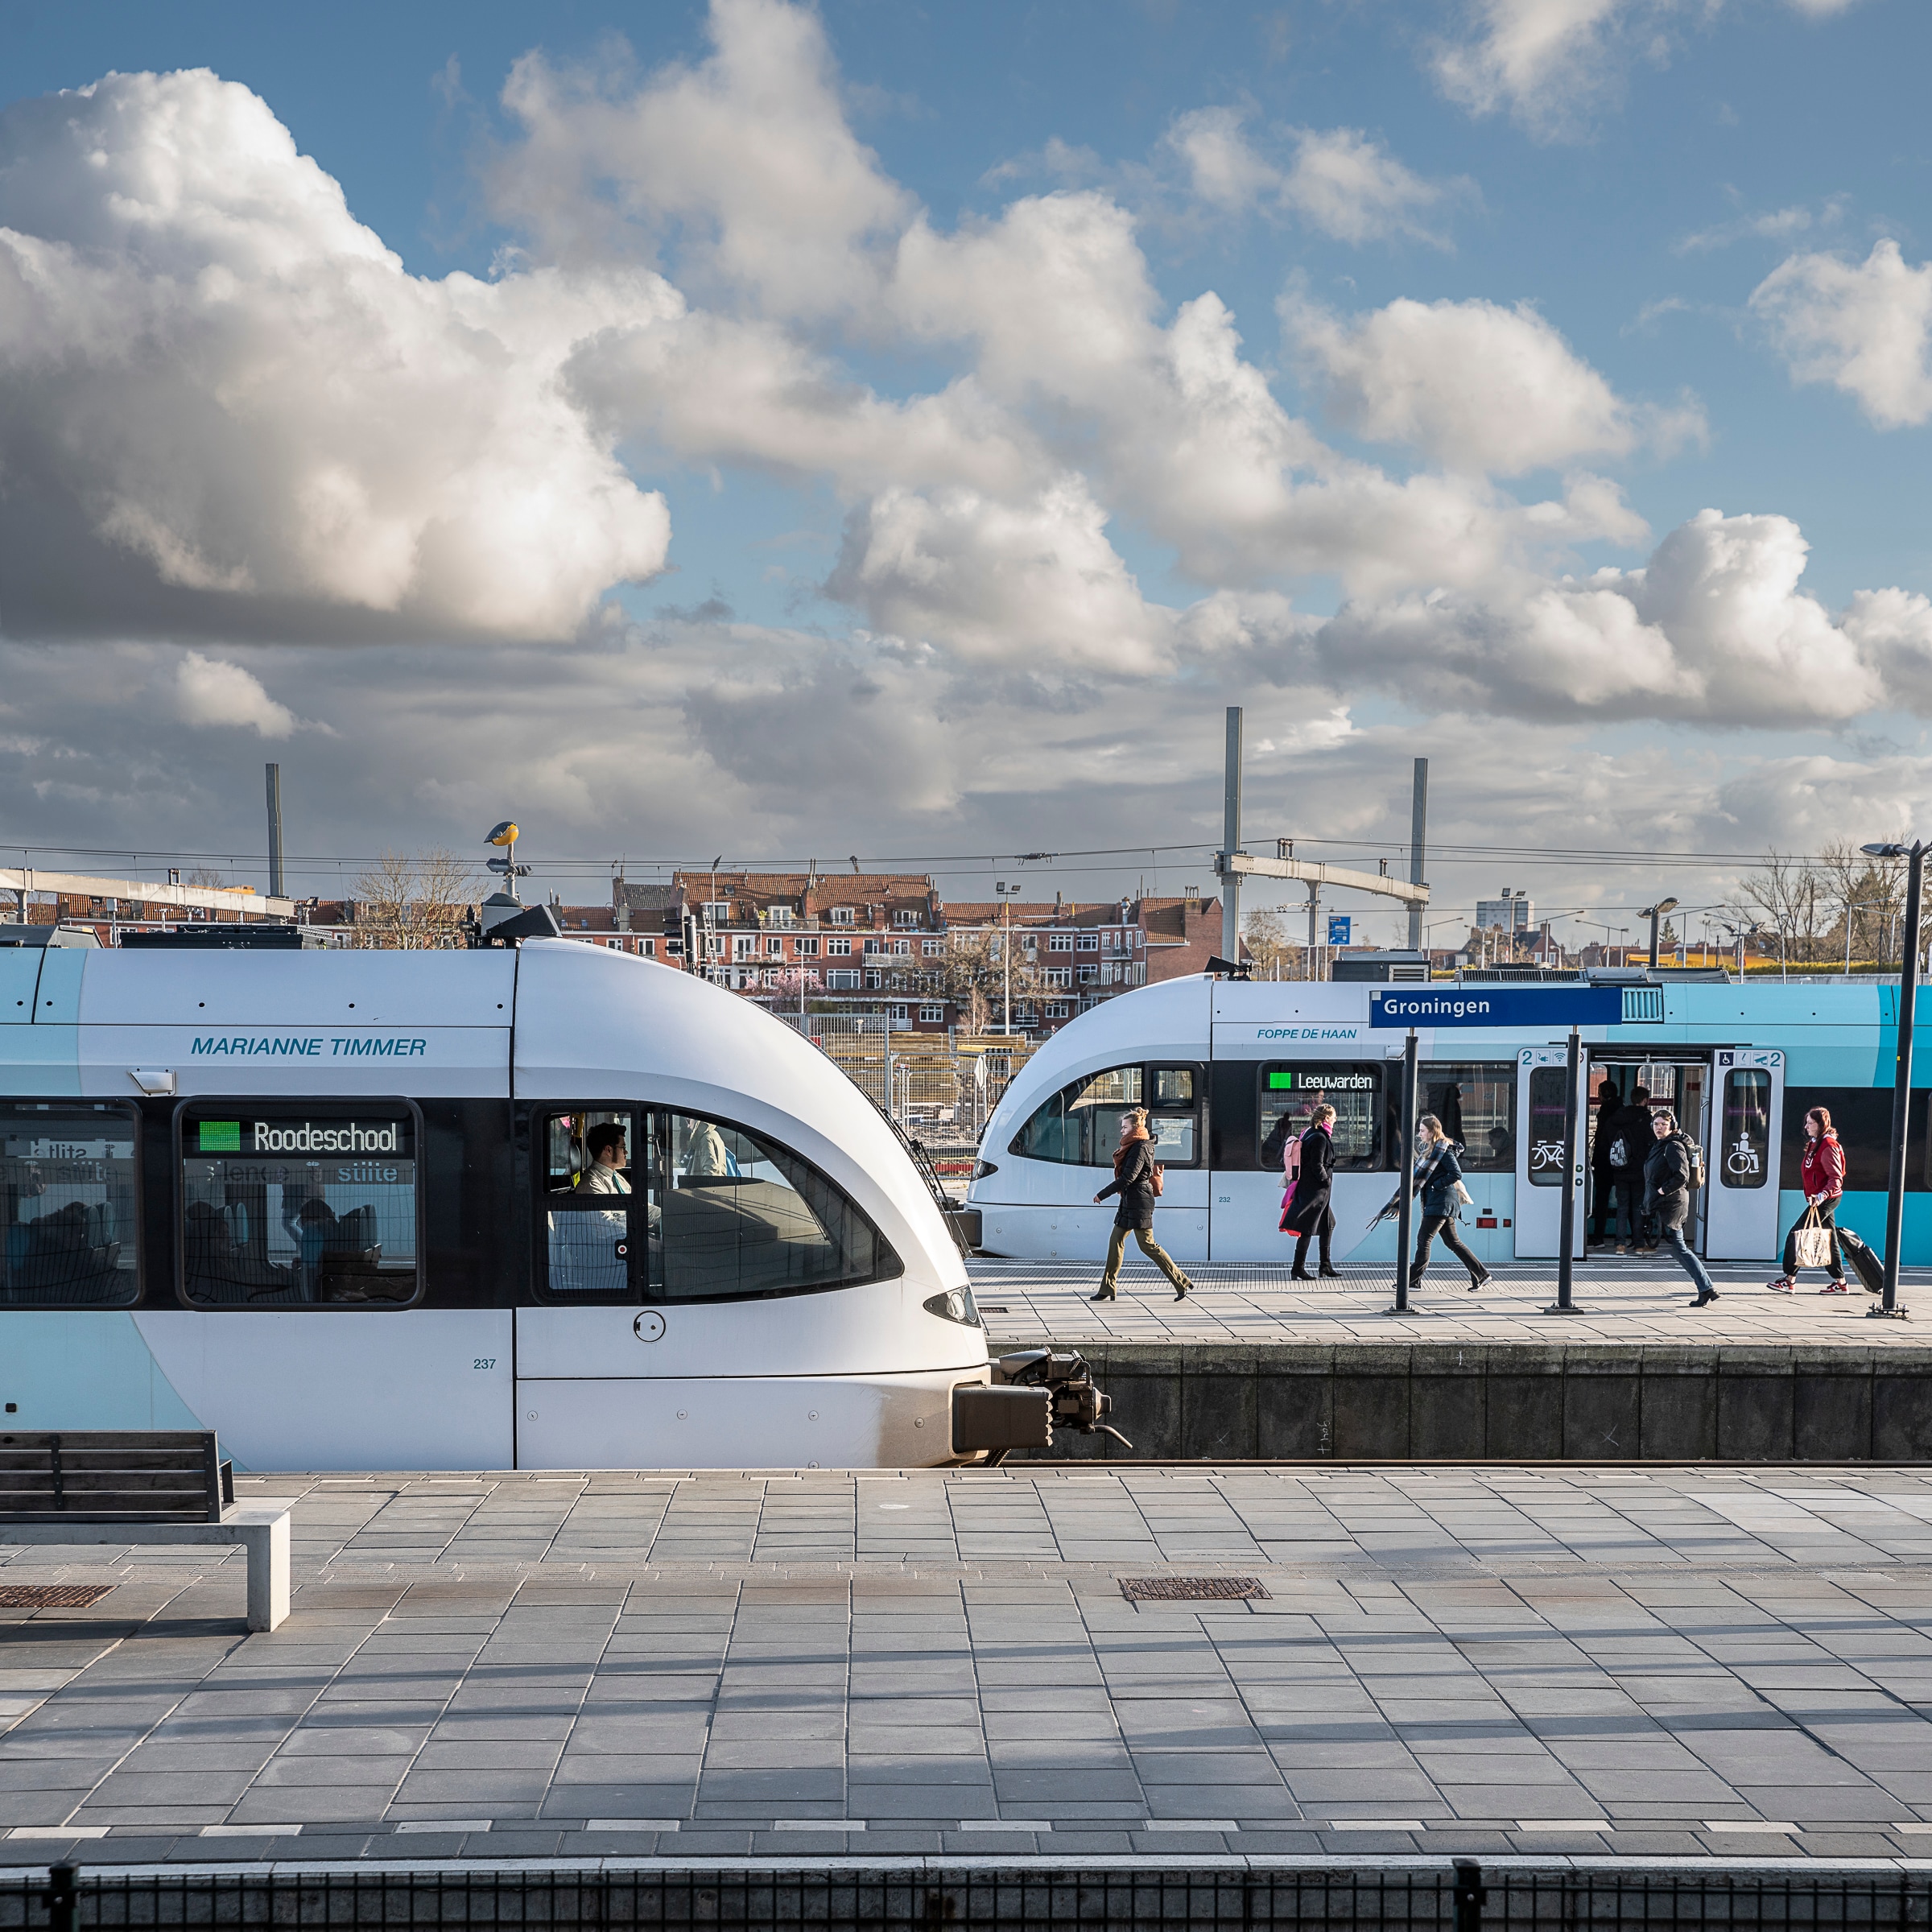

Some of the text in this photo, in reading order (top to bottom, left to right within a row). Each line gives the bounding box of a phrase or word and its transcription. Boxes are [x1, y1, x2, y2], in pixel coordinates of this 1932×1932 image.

[1384, 997, 1490, 1018] Groningen
[1257, 1029, 1357, 1038] FOPPE DE HAAN
[191, 1038, 427, 1056] MARIANNE TIMMER
[1522, 1051, 1533, 1065] 2
[1769, 1052, 1781, 1067] 2
[1298, 1072, 1373, 1089] Leeuwarden
[254, 1122, 398, 1151] Roodeschool
[473, 1358, 497, 1369] 237
